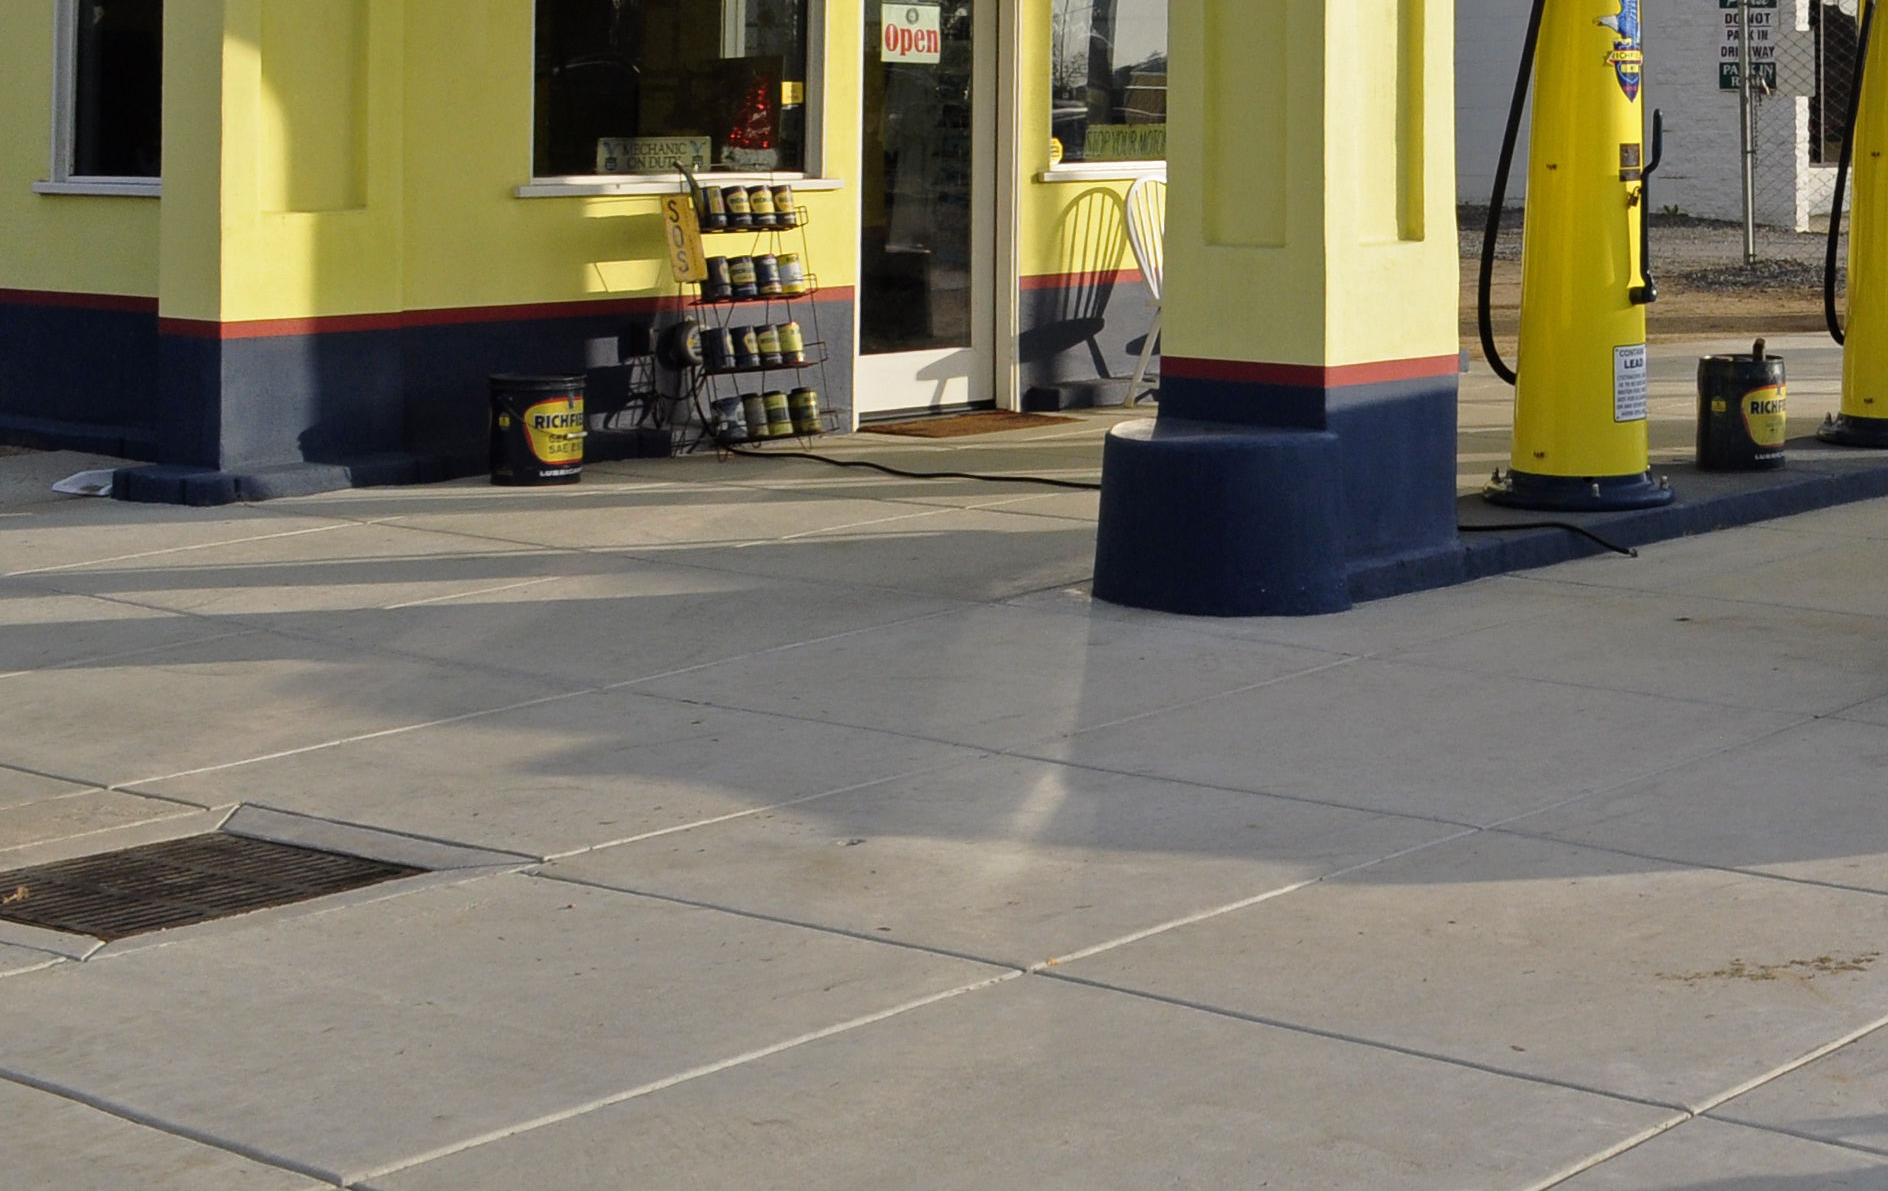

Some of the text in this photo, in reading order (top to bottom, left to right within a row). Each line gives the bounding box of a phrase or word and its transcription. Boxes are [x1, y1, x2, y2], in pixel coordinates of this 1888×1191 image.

[885, 23, 939, 56] Open
[1727, 30, 1769, 41] PAK IN
[1721, 46, 1775, 58] DRIWAY
[1723, 64, 1757, 76] PAK
[622, 142, 688, 155] MECHANIC
[626, 157, 646, 169] ON
